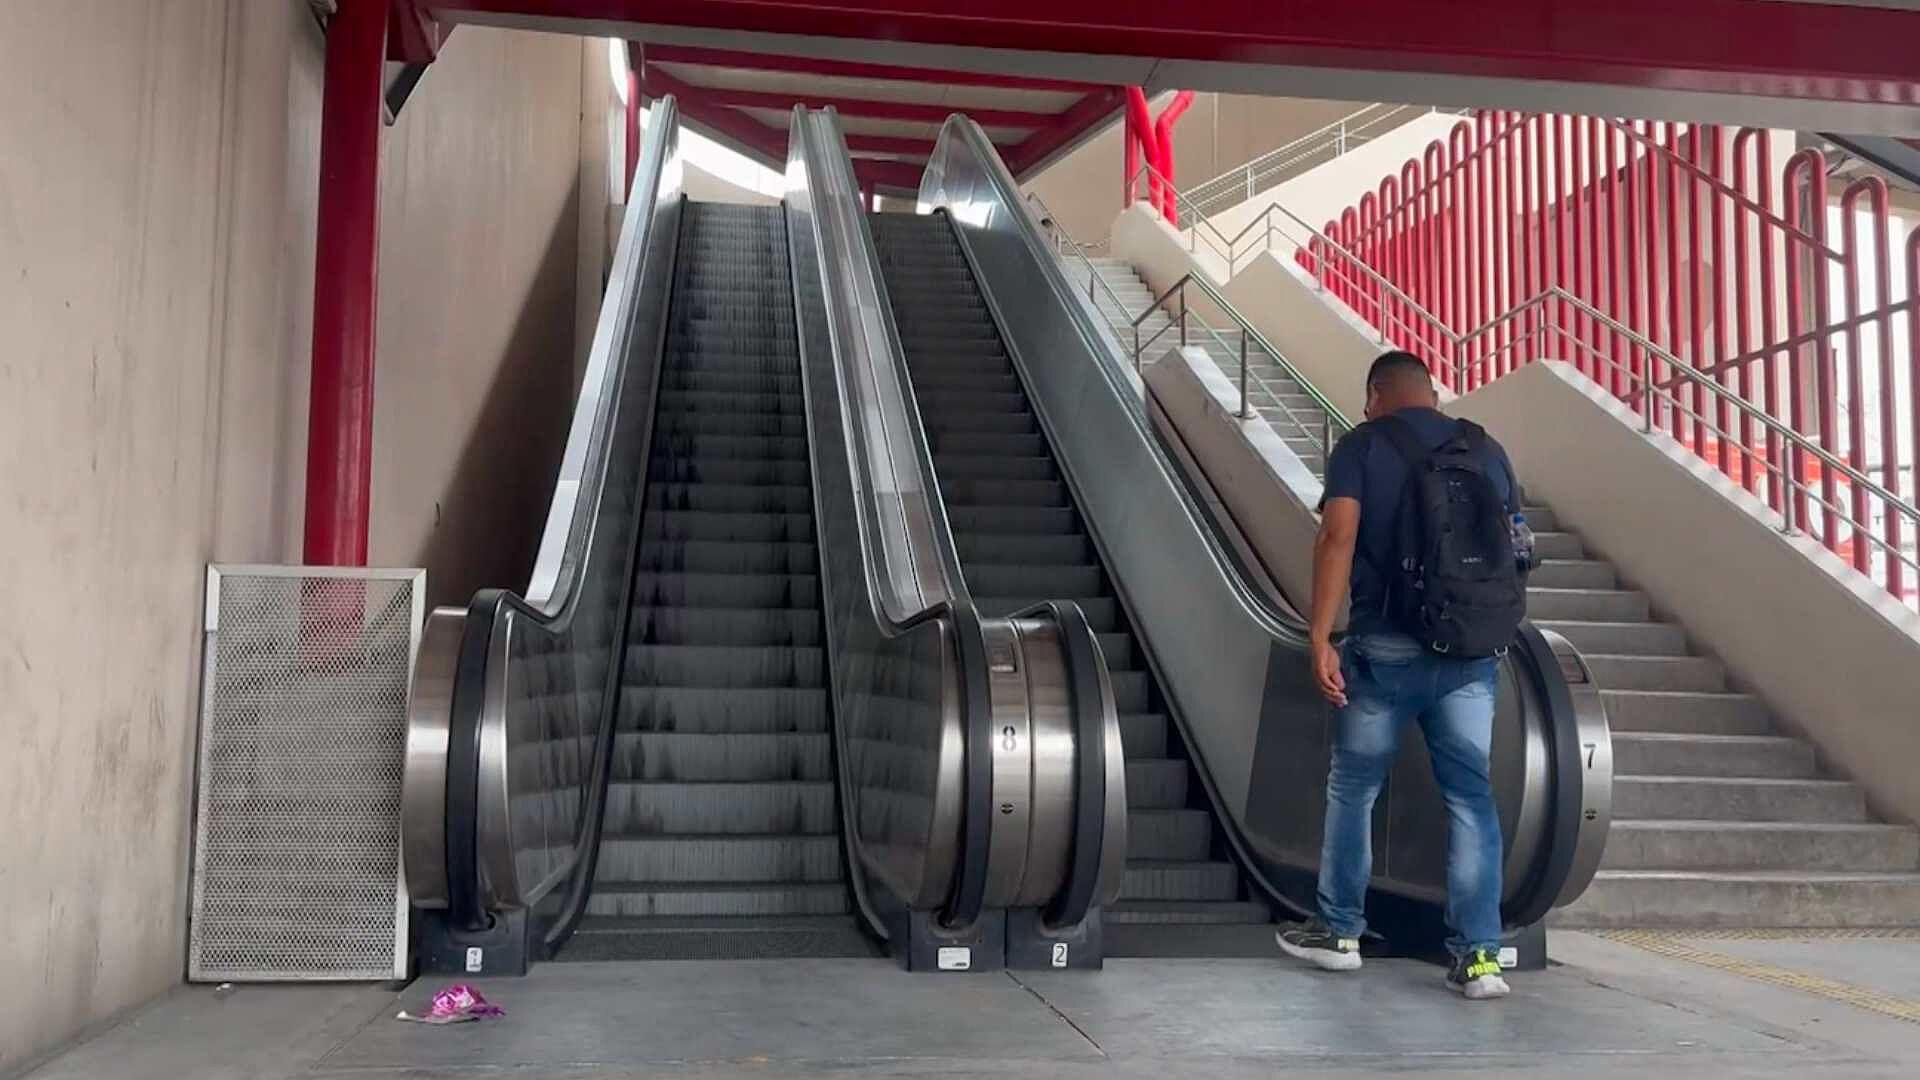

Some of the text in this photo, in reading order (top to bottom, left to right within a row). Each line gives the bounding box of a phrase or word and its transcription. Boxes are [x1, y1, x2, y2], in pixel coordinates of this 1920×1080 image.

[1002, 725, 1017, 752] 8
[1583, 743, 1597, 770] 7
[1055, 945, 1065, 963] 2
